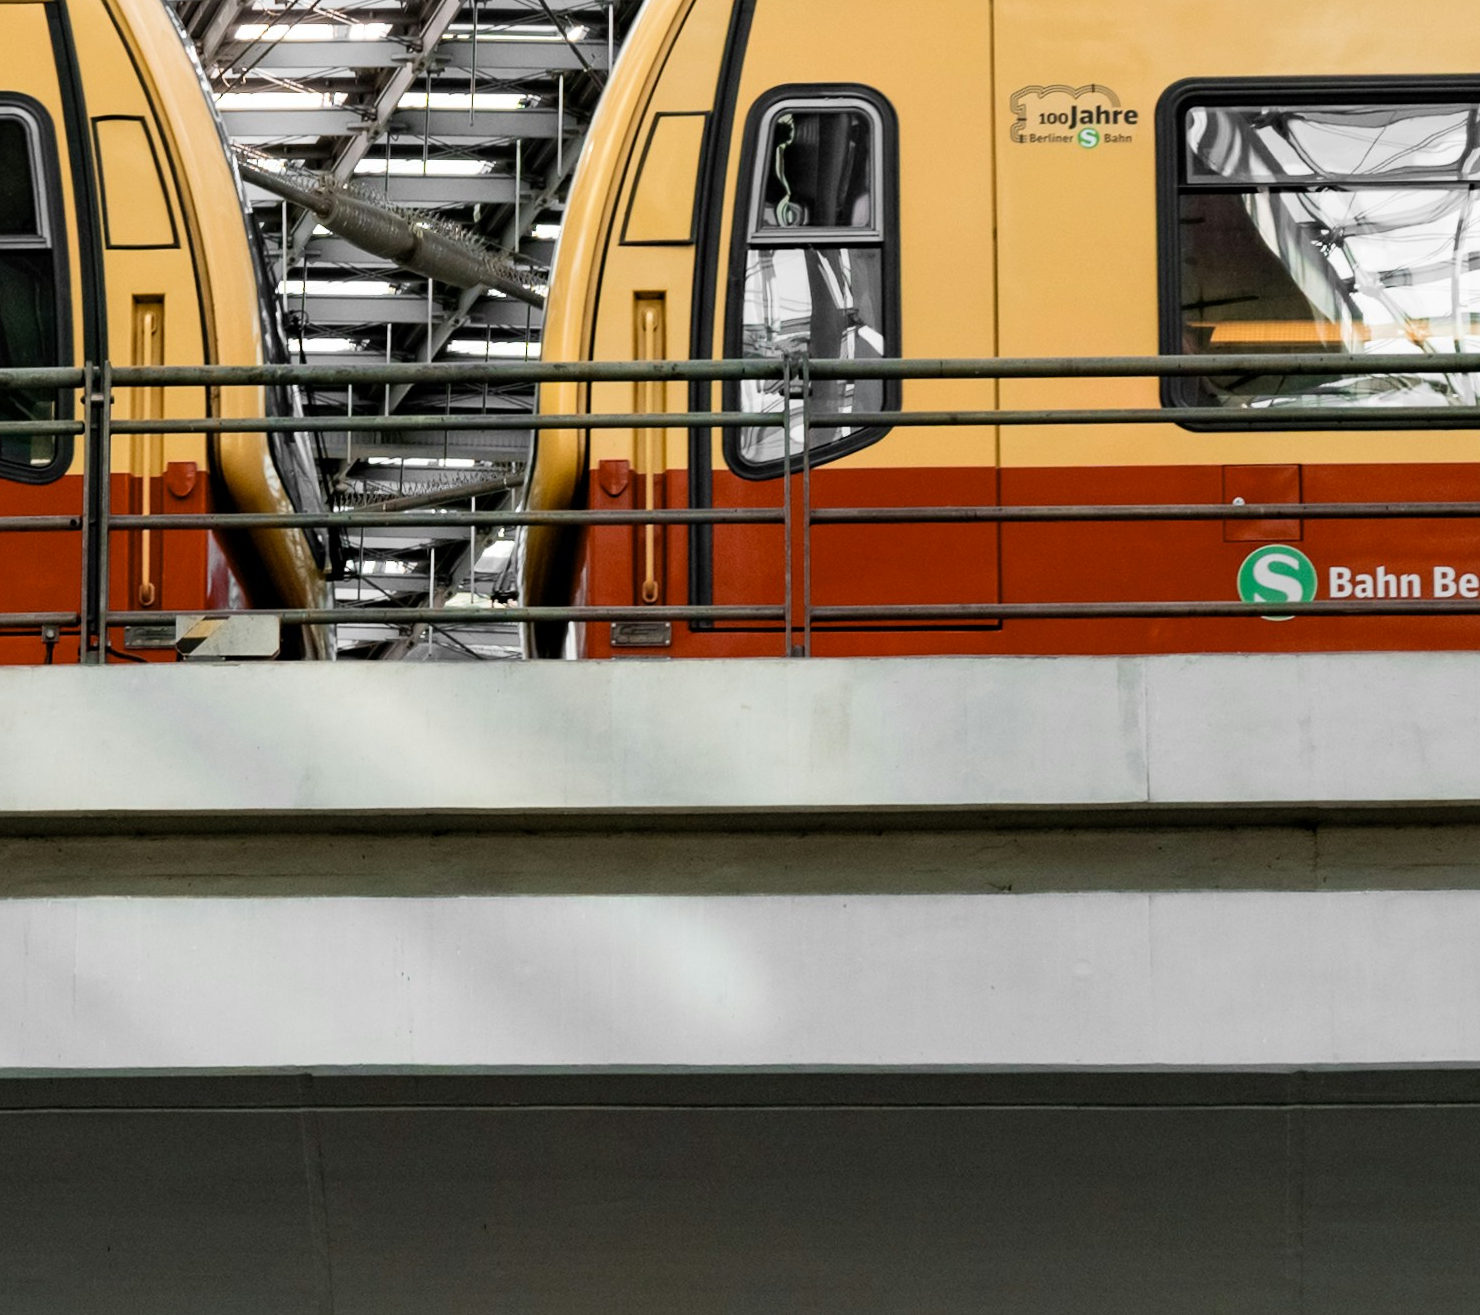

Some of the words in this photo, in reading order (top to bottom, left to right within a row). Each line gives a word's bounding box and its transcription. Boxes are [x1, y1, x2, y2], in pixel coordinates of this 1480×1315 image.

[1039, 112, 1068, 125] 100
[1069, 105, 1138, 130] Jahre
[1029, 133, 1074, 143] Berliner
[1079, 128, 1098, 148] S
[1104, 133, 1132, 143] Bahn
[1252, 552, 1304, 603] S
[1329, 565, 1422, 598] Bahn
